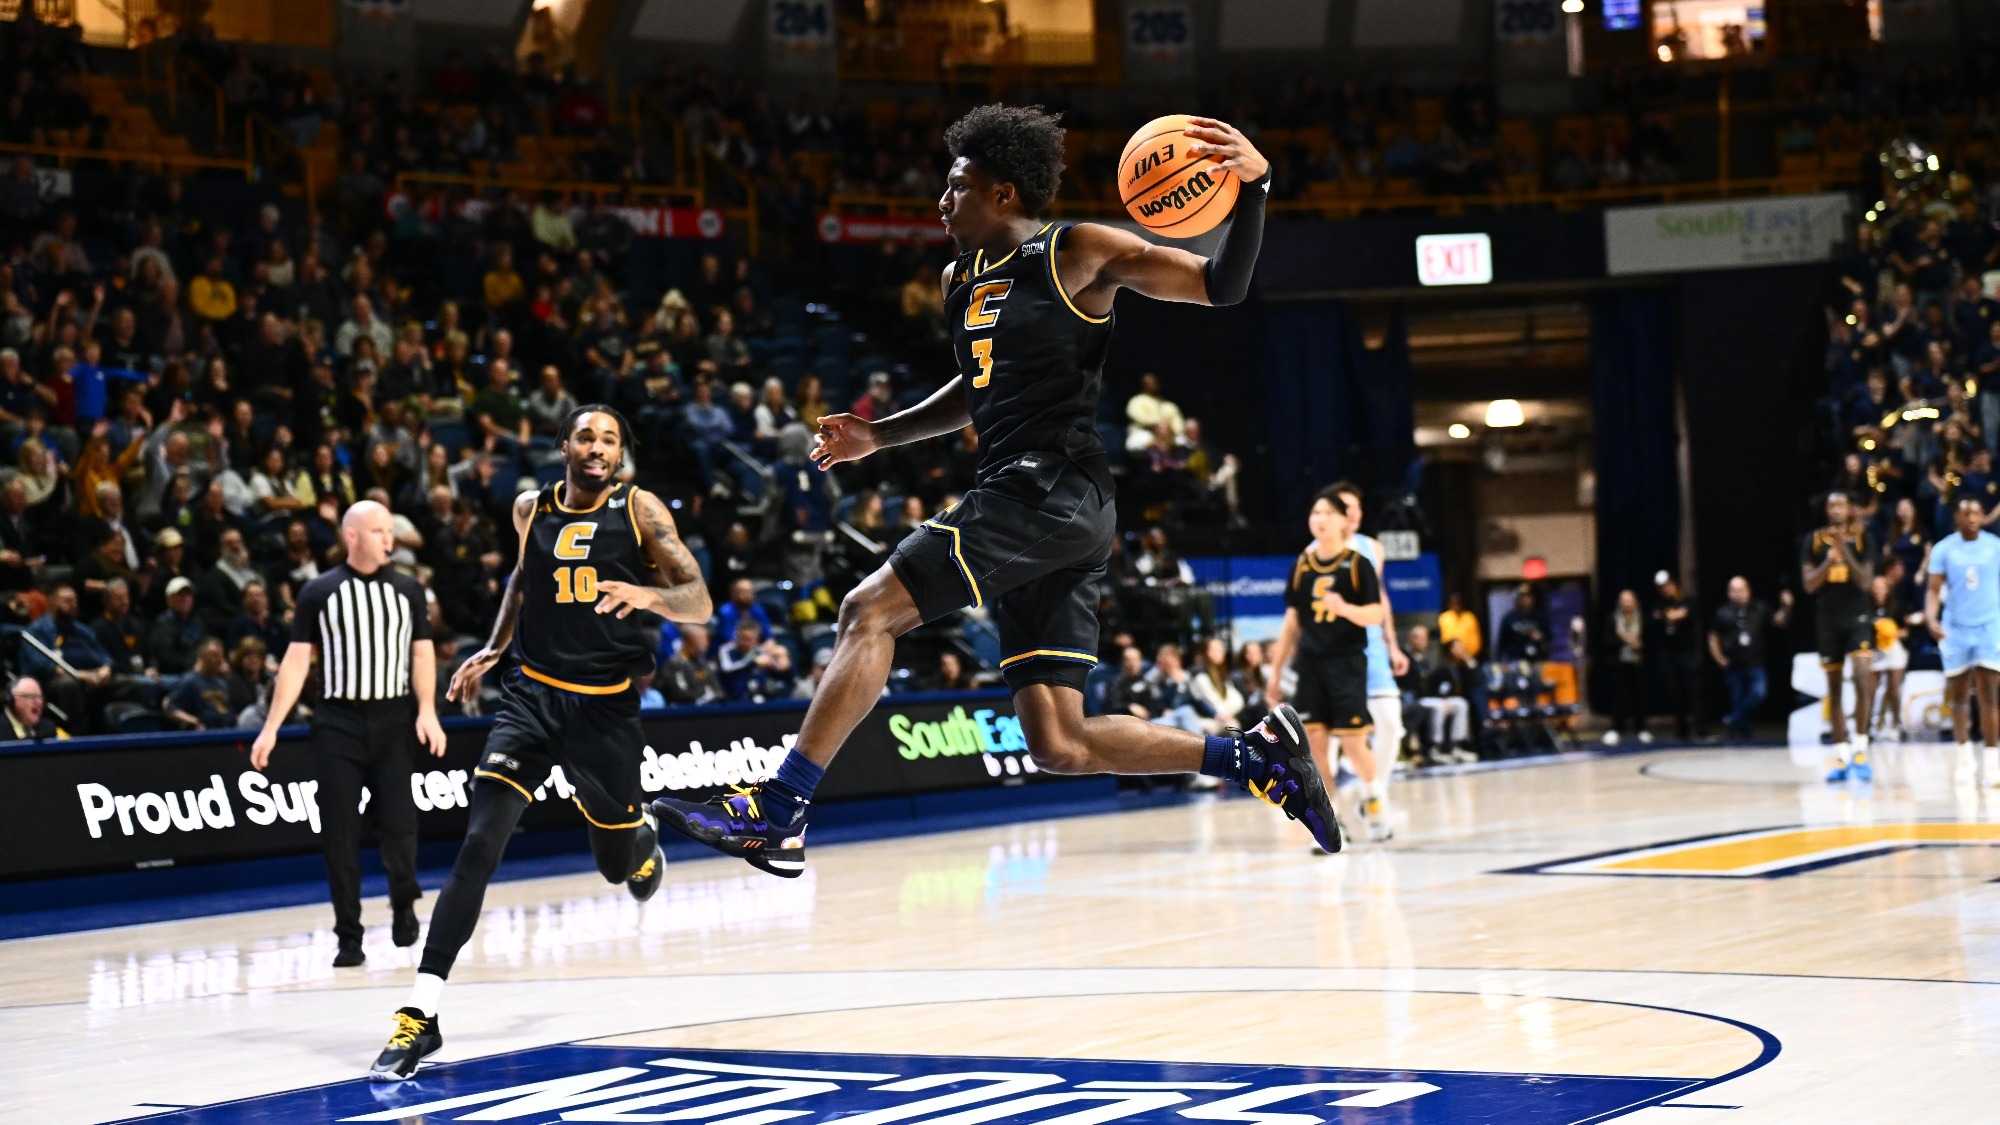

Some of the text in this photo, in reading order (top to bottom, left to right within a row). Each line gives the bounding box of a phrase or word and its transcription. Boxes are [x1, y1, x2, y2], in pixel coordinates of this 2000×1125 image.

[1138, 171, 1216, 218] Wilson
[1021, 240, 1046, 258] SOCON
[1424, 242, 1480, 278] EXIT
[964, 278, 1015, 331] C
[971, 338, 994, 389] 3
[554, 521, 599, 561] C
[553, 566, 598, 603] 10
[77, 774, 235, 838] Proud
